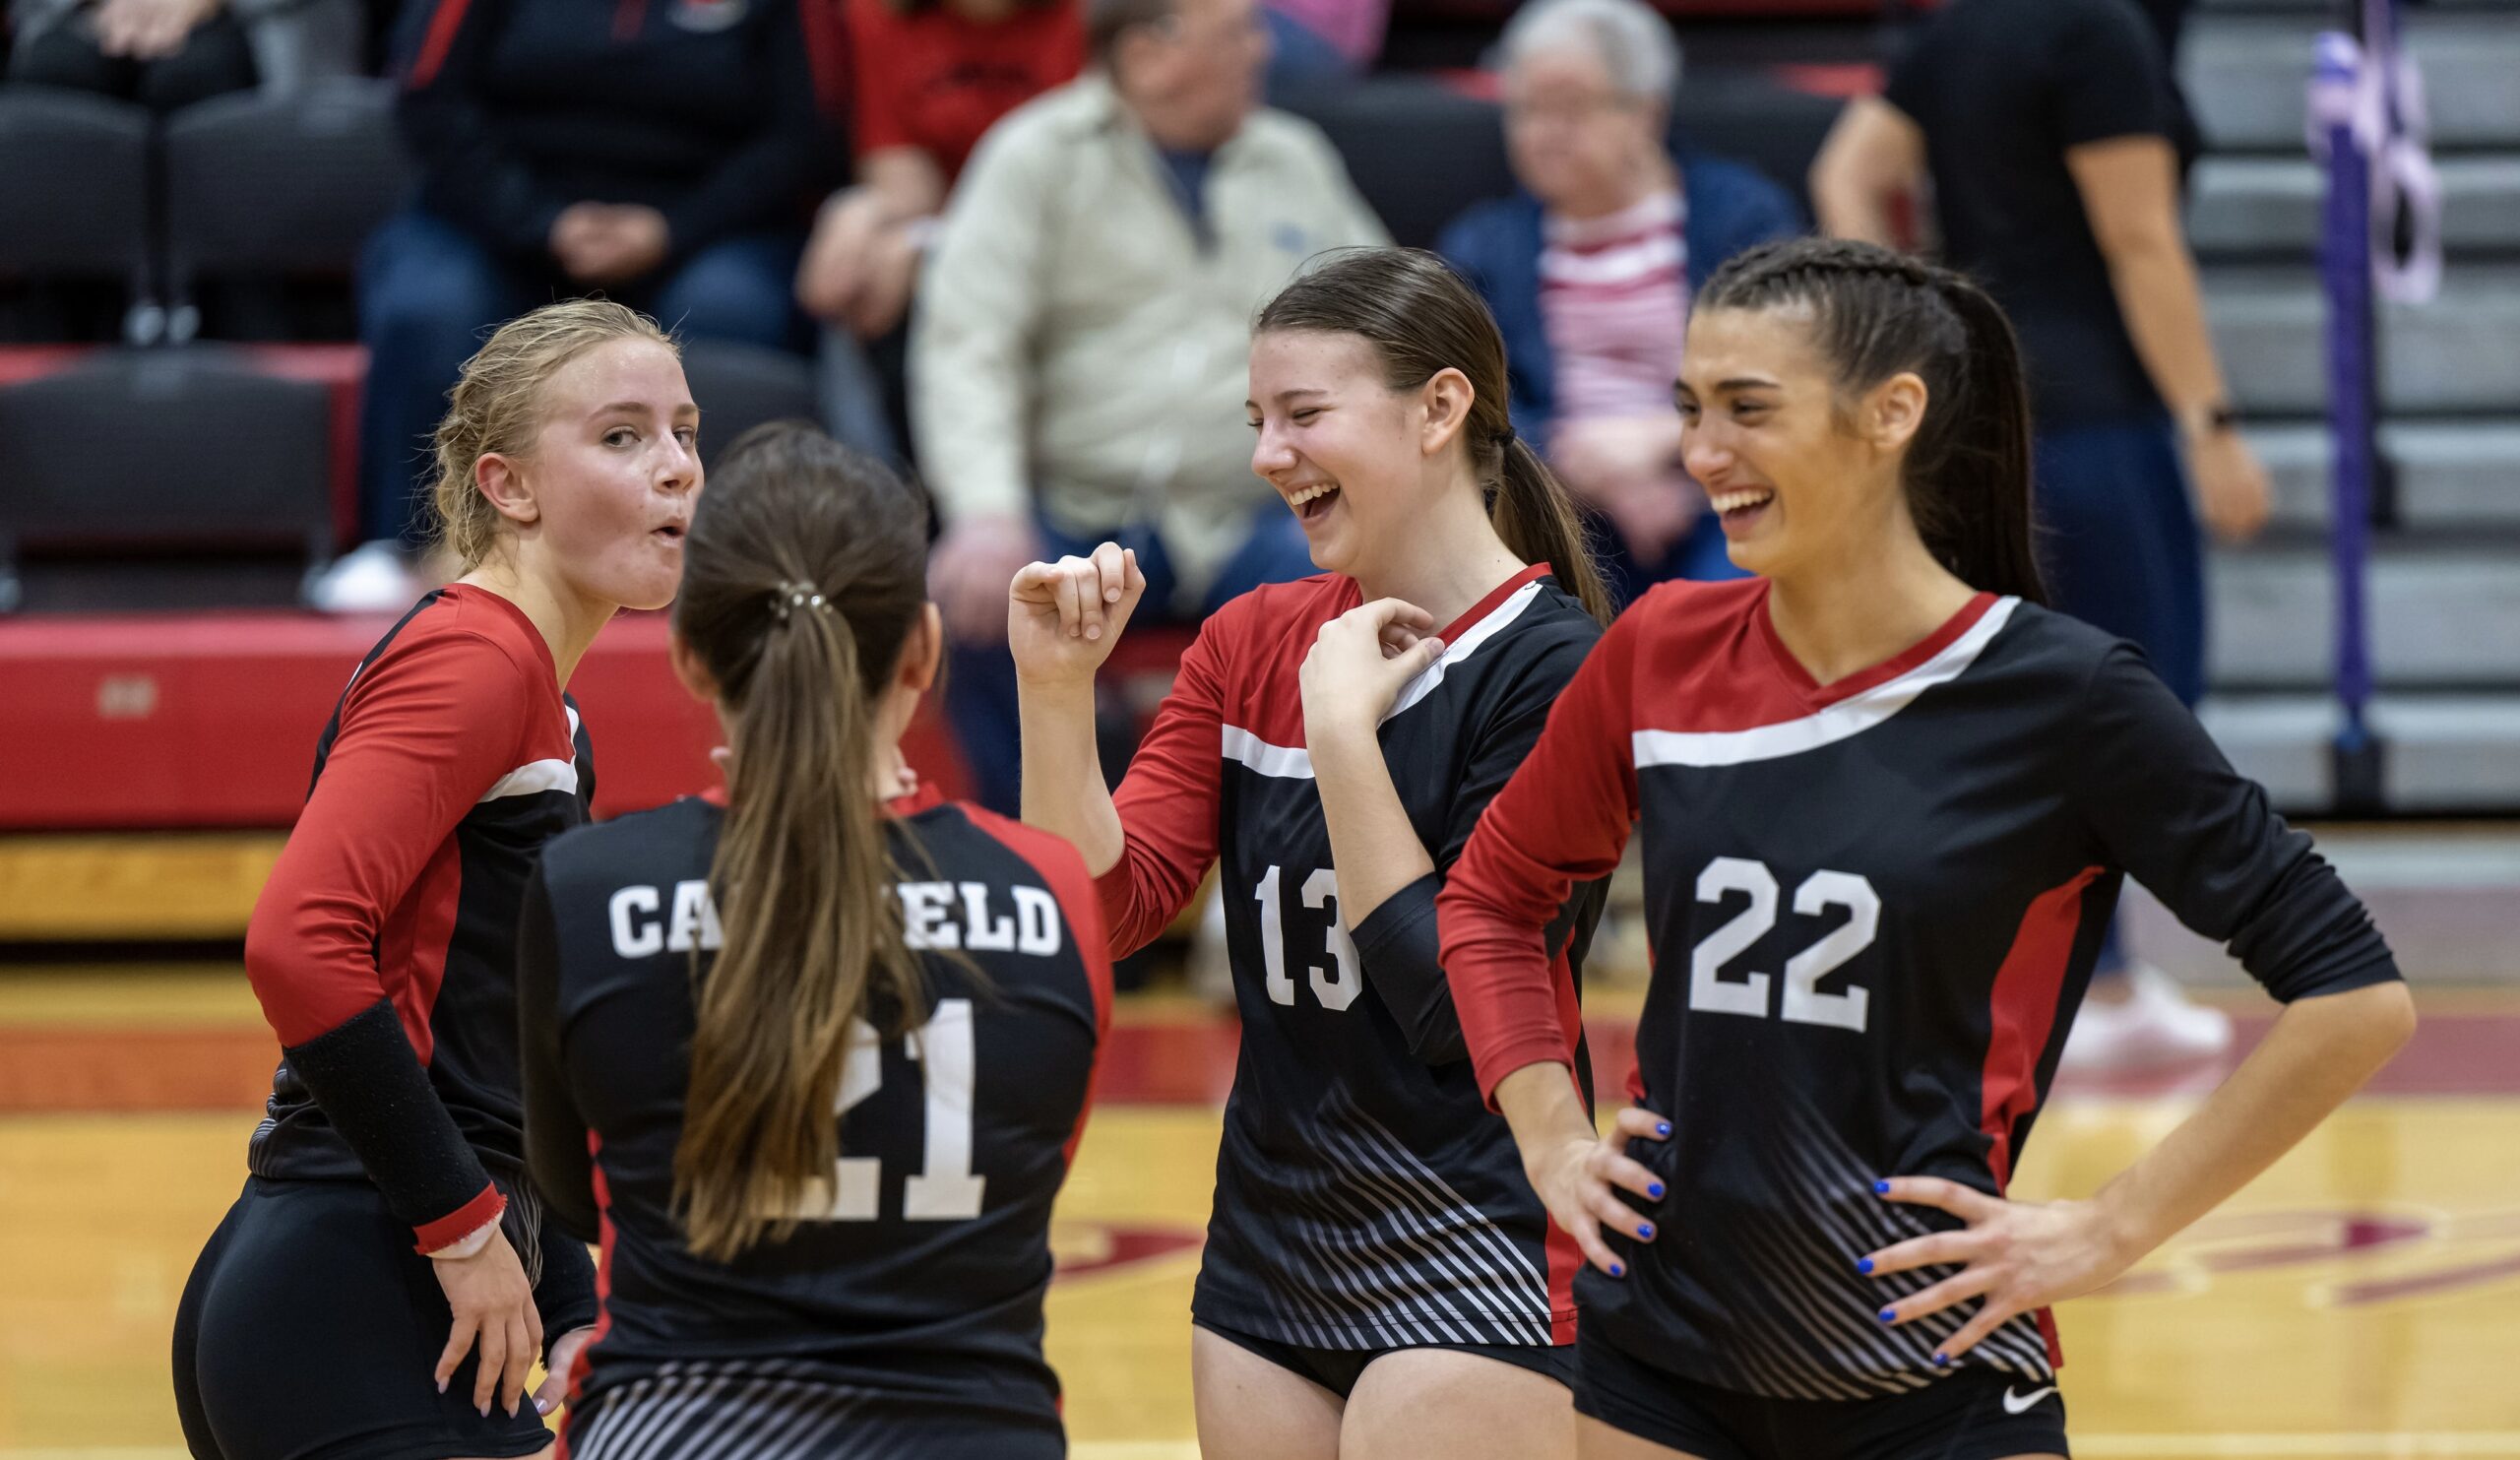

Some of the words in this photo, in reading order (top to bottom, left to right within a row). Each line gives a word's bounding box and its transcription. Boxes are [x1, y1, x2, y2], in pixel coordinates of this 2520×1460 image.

[609, 879, 1061, 958] CAELD
[1254, 864, 1362, 1012] 13
[1689, 856, 1881, 1033] 22
